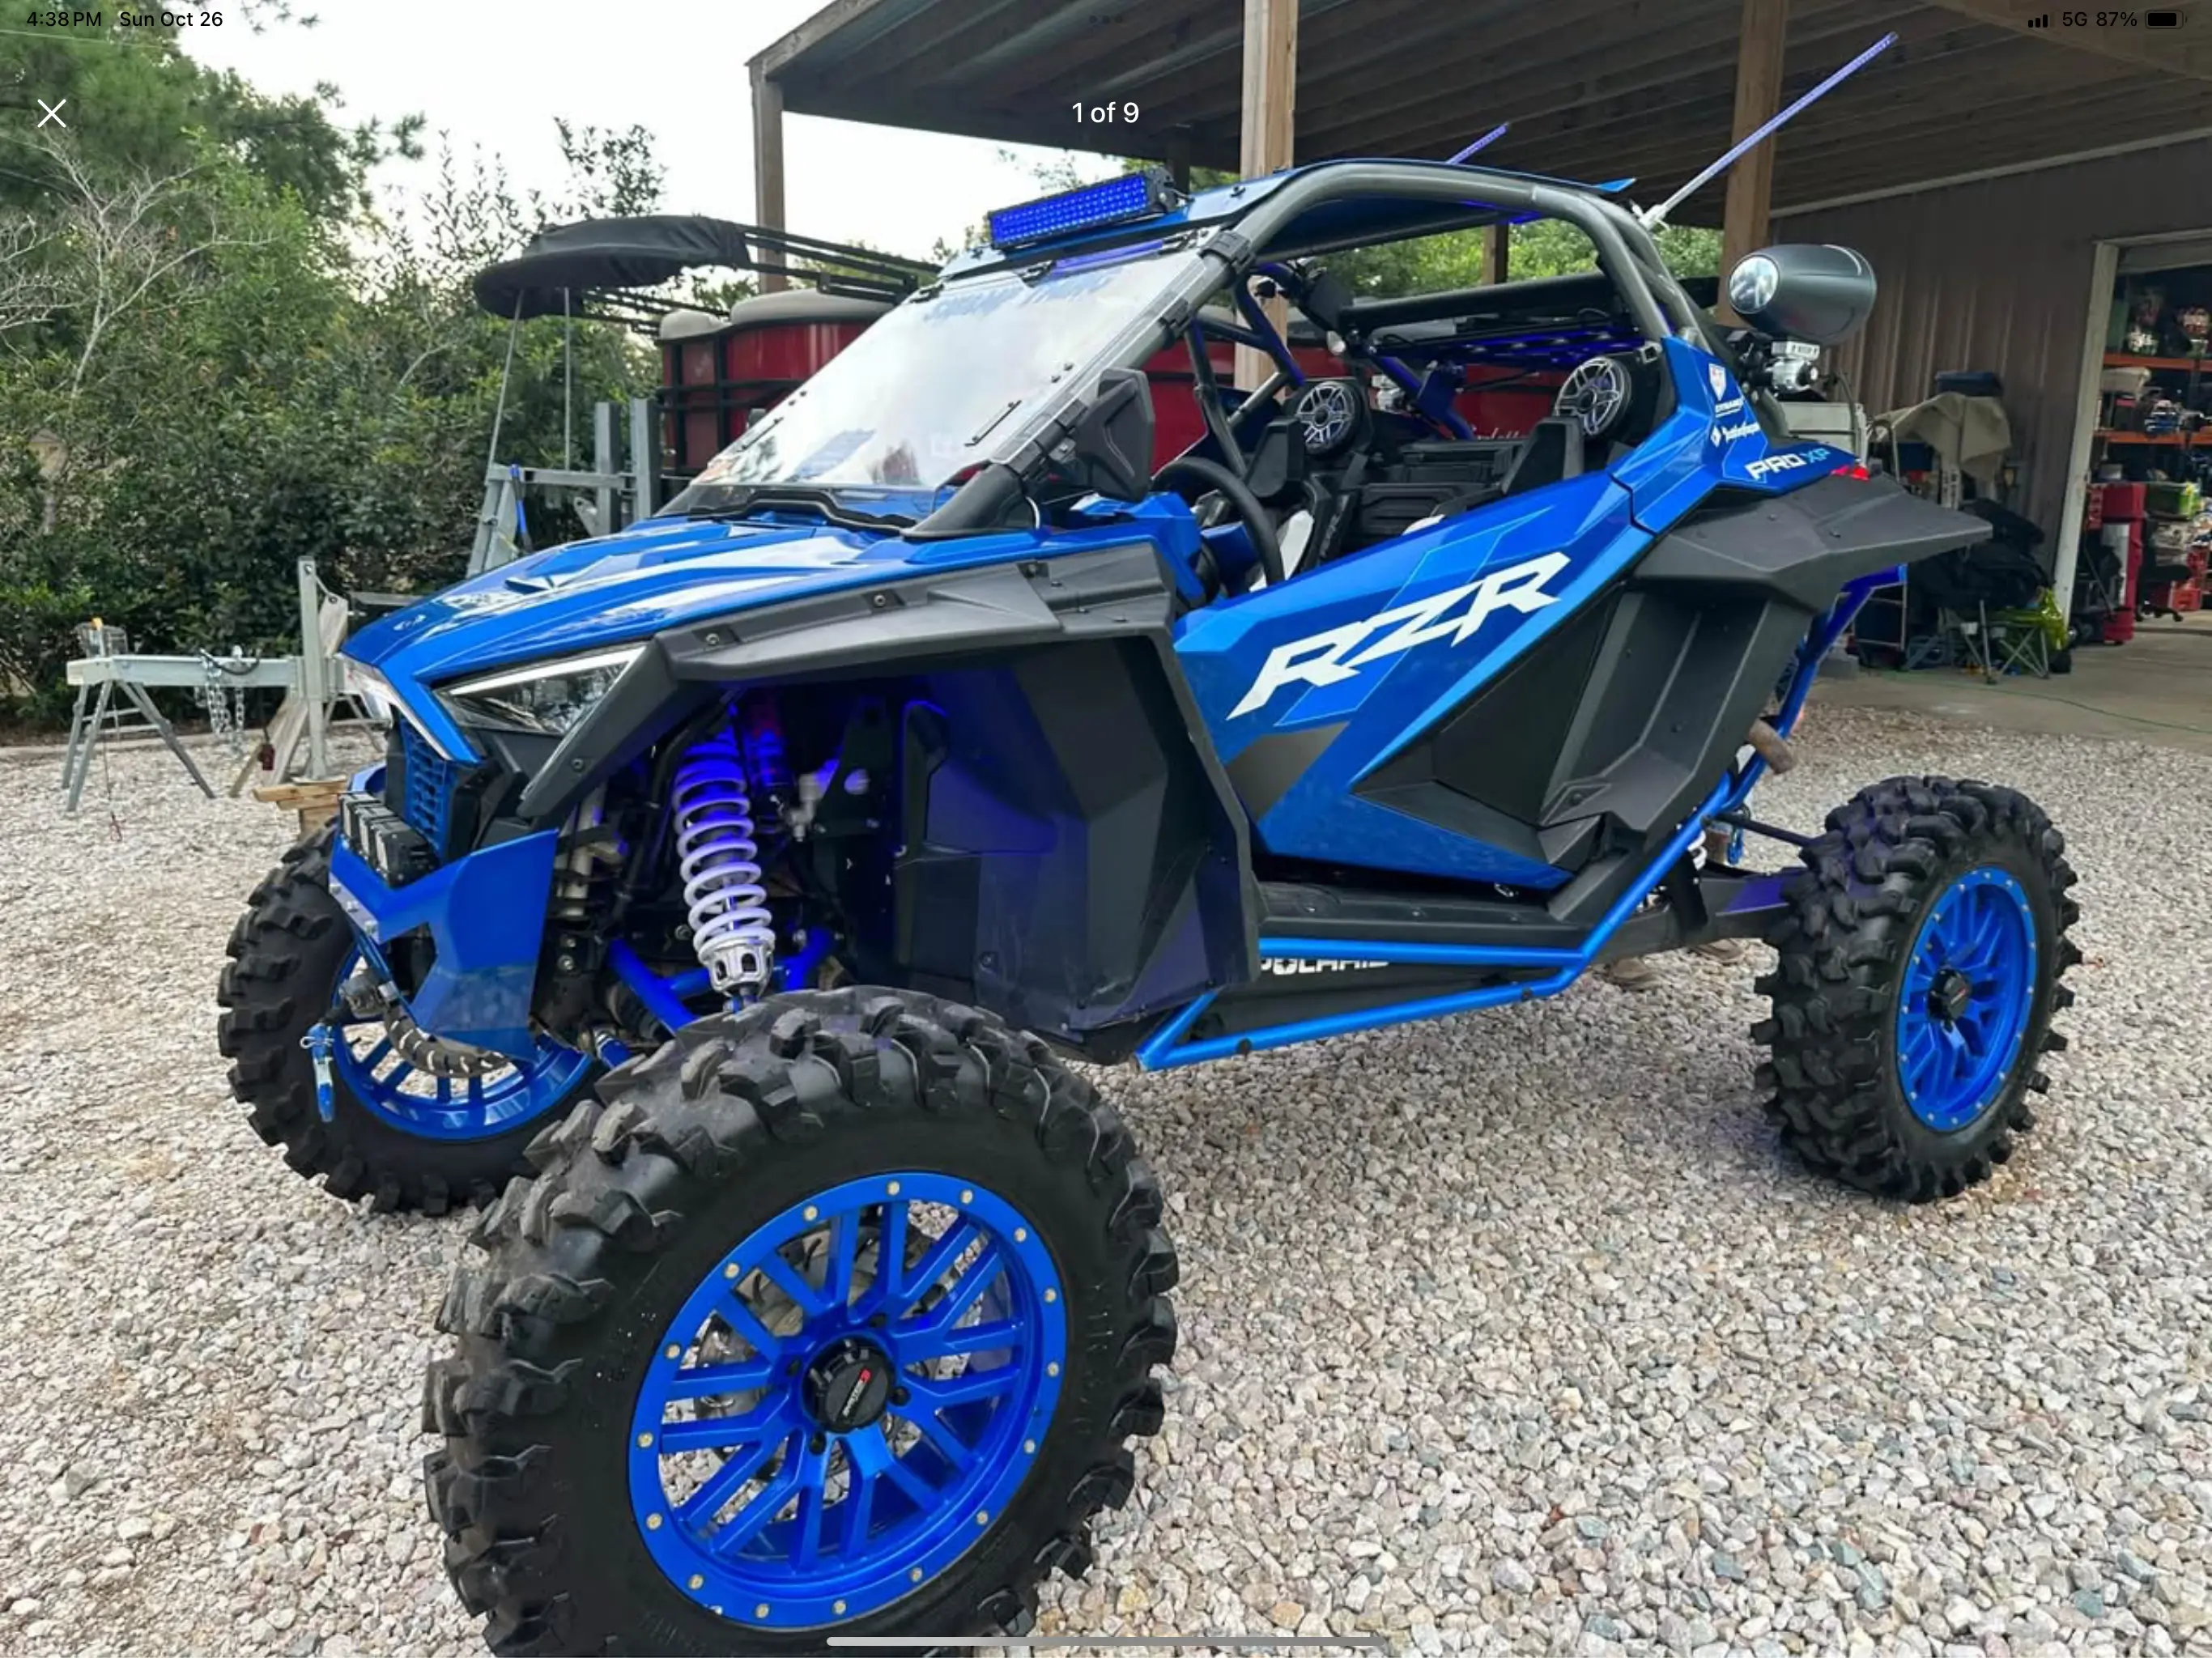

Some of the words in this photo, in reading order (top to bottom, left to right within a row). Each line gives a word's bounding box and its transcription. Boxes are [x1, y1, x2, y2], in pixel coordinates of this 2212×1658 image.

[1744, 453, 1806, 480] PRO
[1800, 448, 1831, 464] XP
[1225, 551, 1571, 720] RZR
